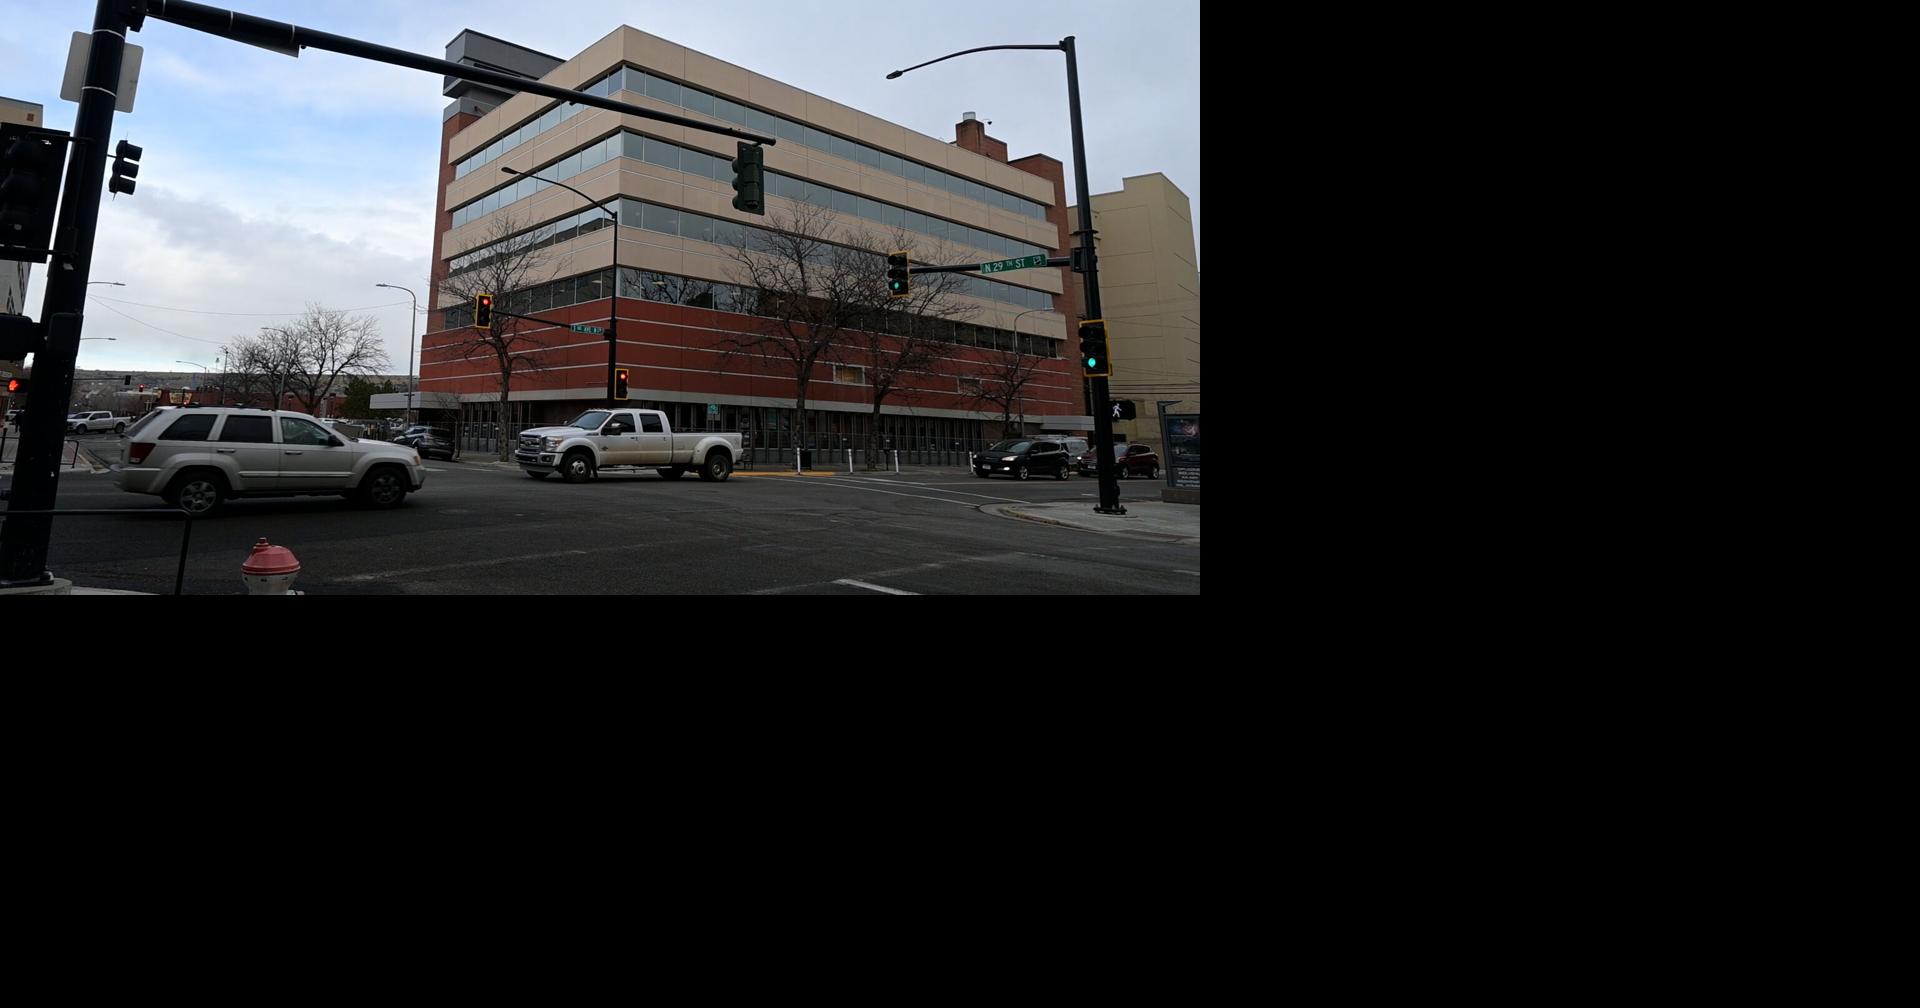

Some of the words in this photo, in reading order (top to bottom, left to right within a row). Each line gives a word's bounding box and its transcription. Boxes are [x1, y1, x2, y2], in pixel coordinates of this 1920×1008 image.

[985, 264, 991, 272] N
[993, 262, 1003, 272] 29
[1015, 259, 1025, 269] ST
